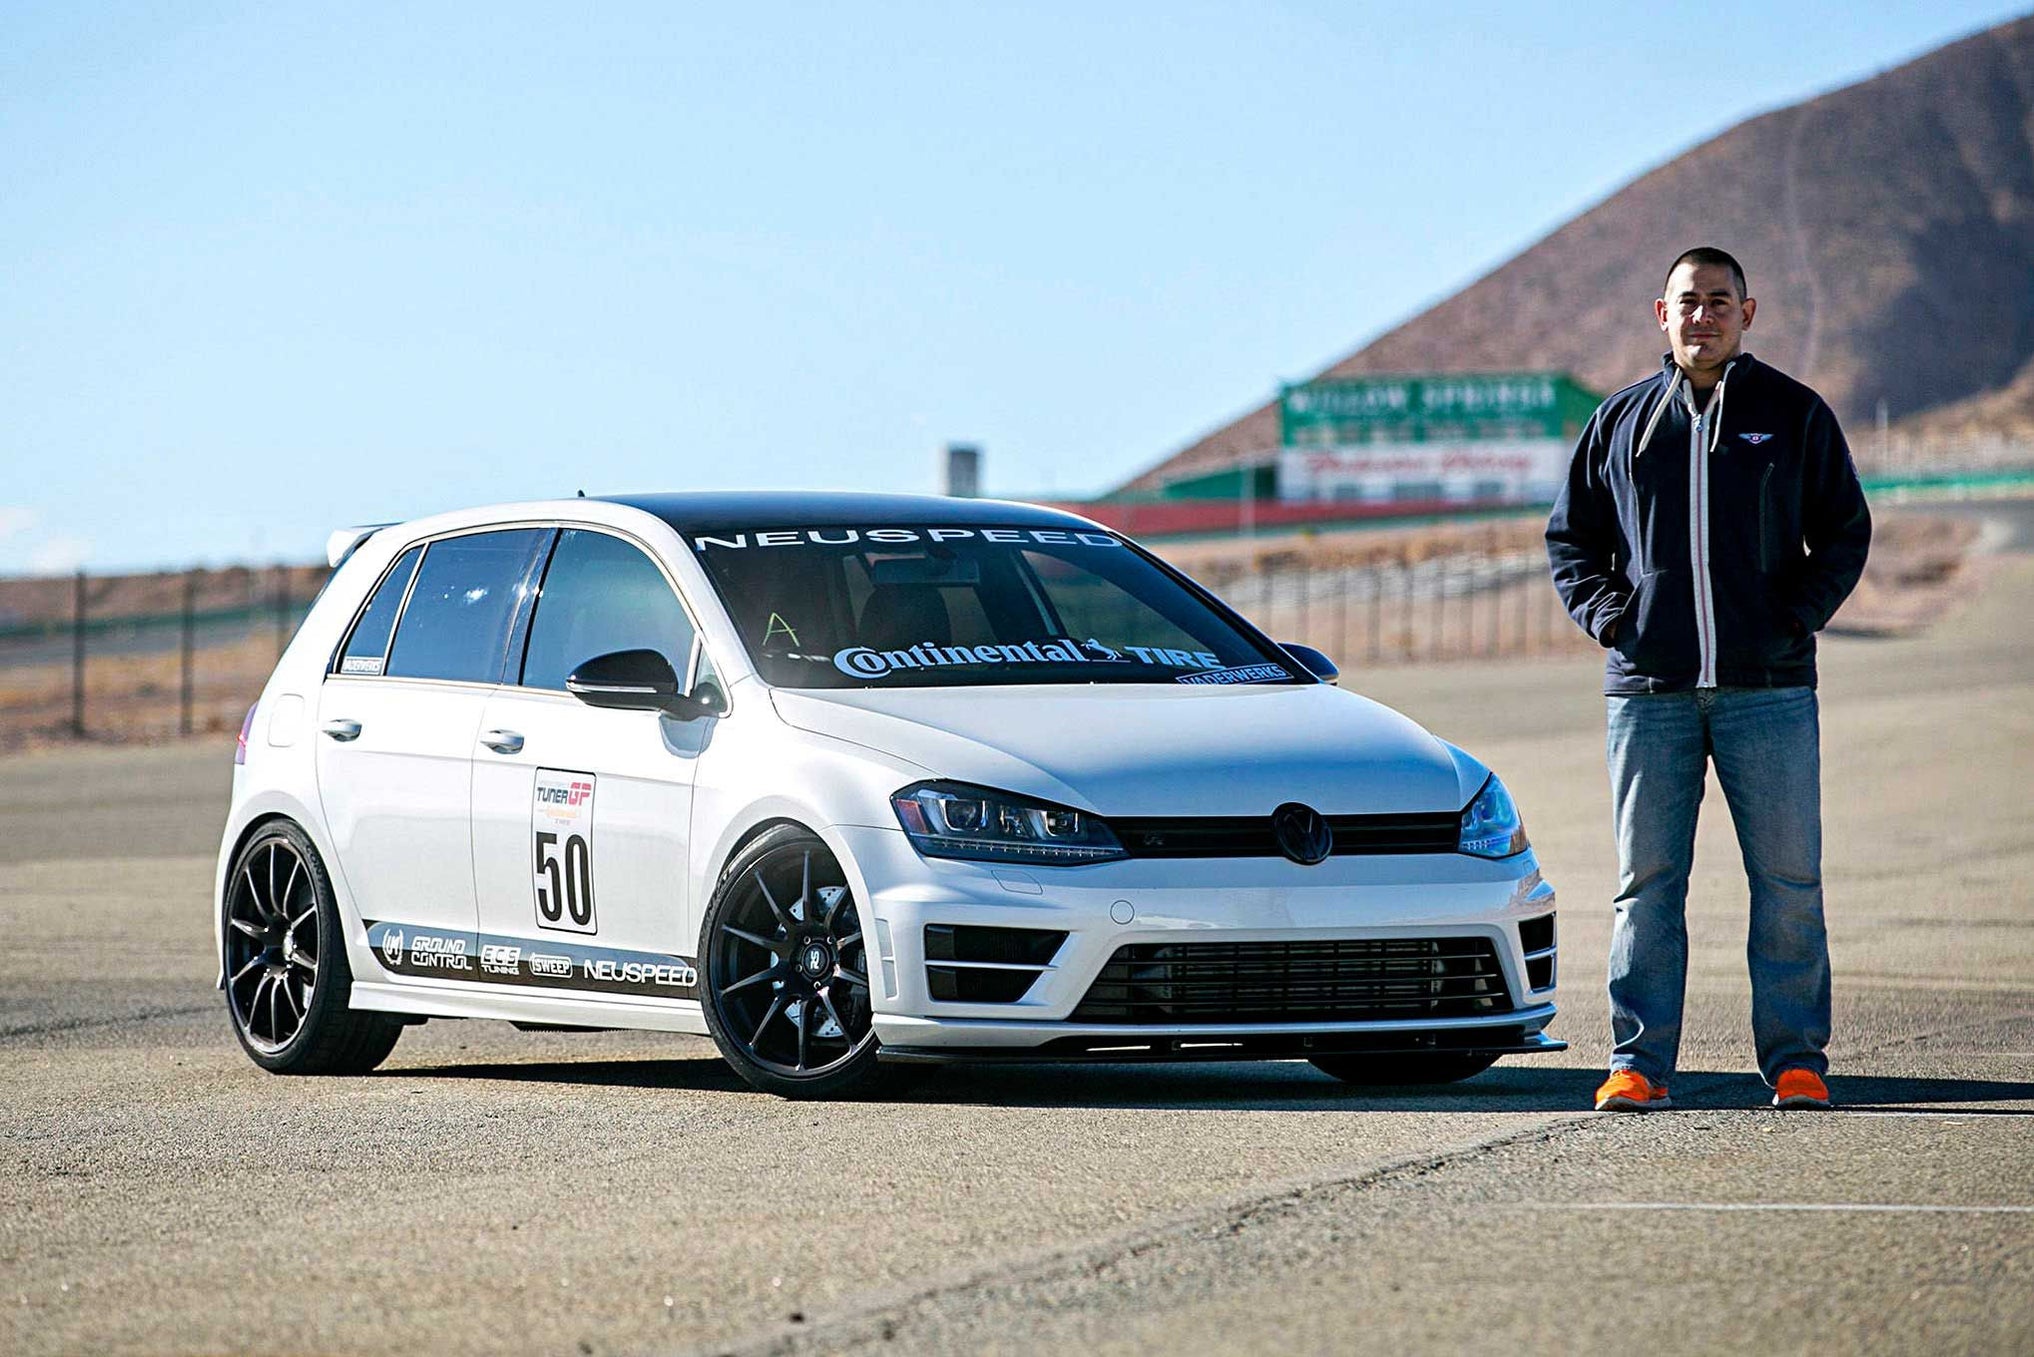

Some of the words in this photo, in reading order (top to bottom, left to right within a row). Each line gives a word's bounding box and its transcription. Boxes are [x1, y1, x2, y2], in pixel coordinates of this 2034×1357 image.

[695, 528, 1123, 551] NEUSPEED
[762, 612, 800, 647] A
[833, 639, 1090, 679] Continental
[1124, 646, 1227, 670] TIRE
[536, 831, 591, 925] 50
[411, 935, 466, 955] GROUND
[411, 951, 473, 971] CONTROL
[481, 964, 520, 976] TUNING
[583, 959, 698, 988] NEUSPEED
